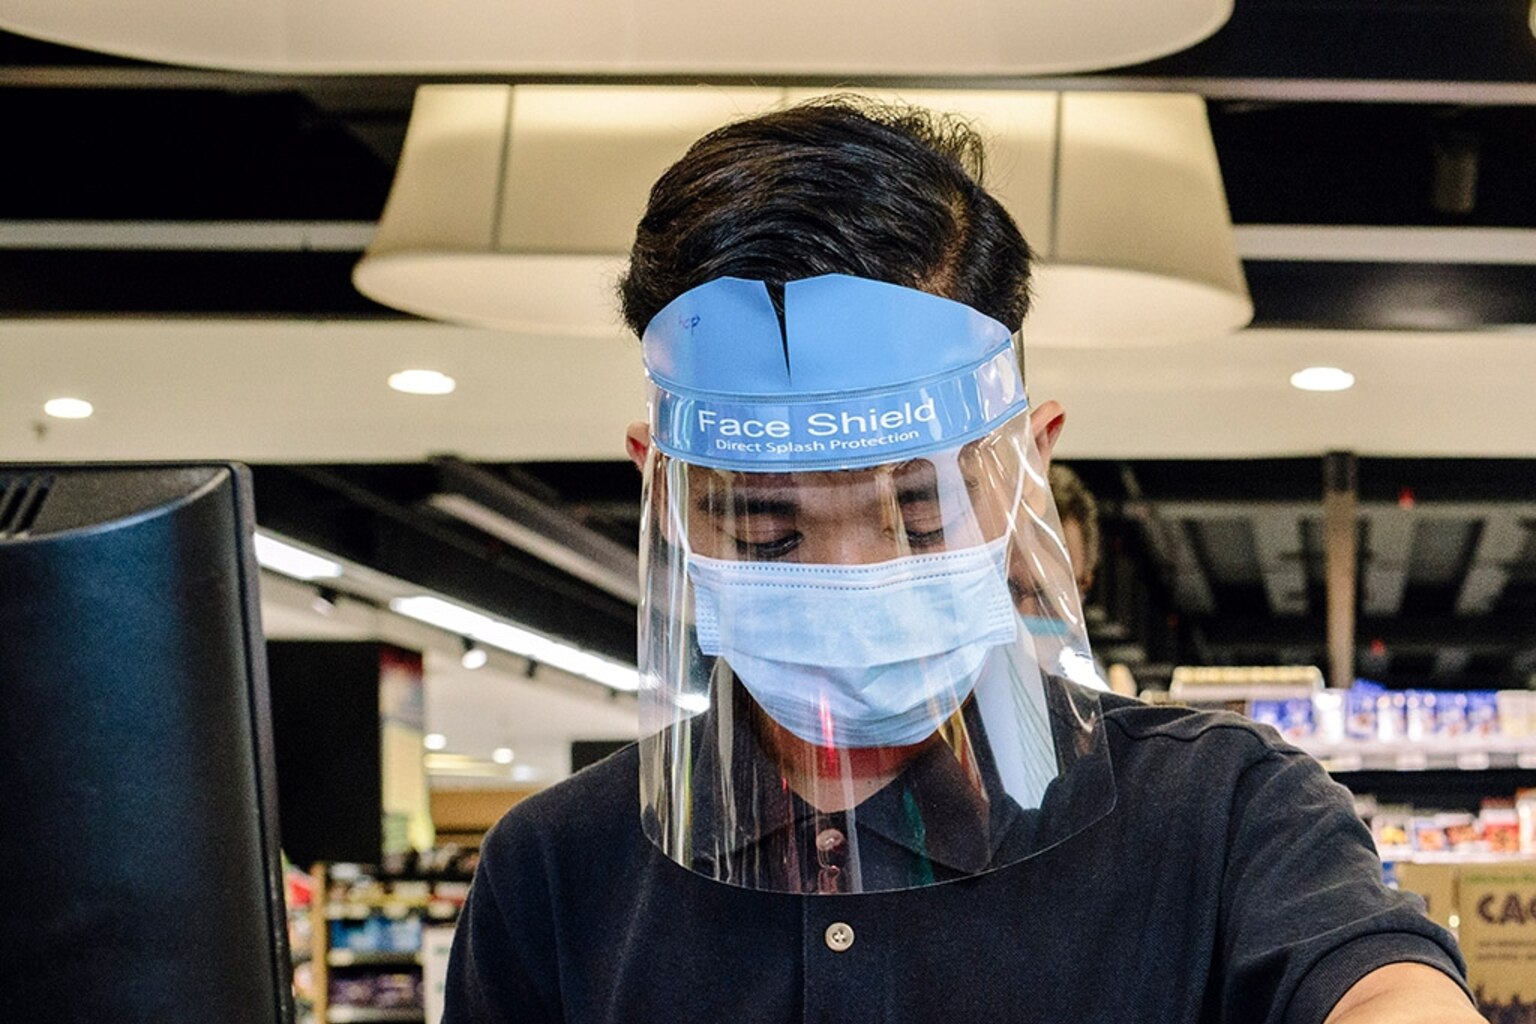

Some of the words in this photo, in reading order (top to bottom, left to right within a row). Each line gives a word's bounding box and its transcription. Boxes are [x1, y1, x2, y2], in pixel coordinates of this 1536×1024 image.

[698, 410, 790, 437] Face
[807, 398, 937, 436] Shield
[716, 439, 762, 452] Direct
[766, 438, 825, 455] Splash
[829, 429, 919, 450] Protection
